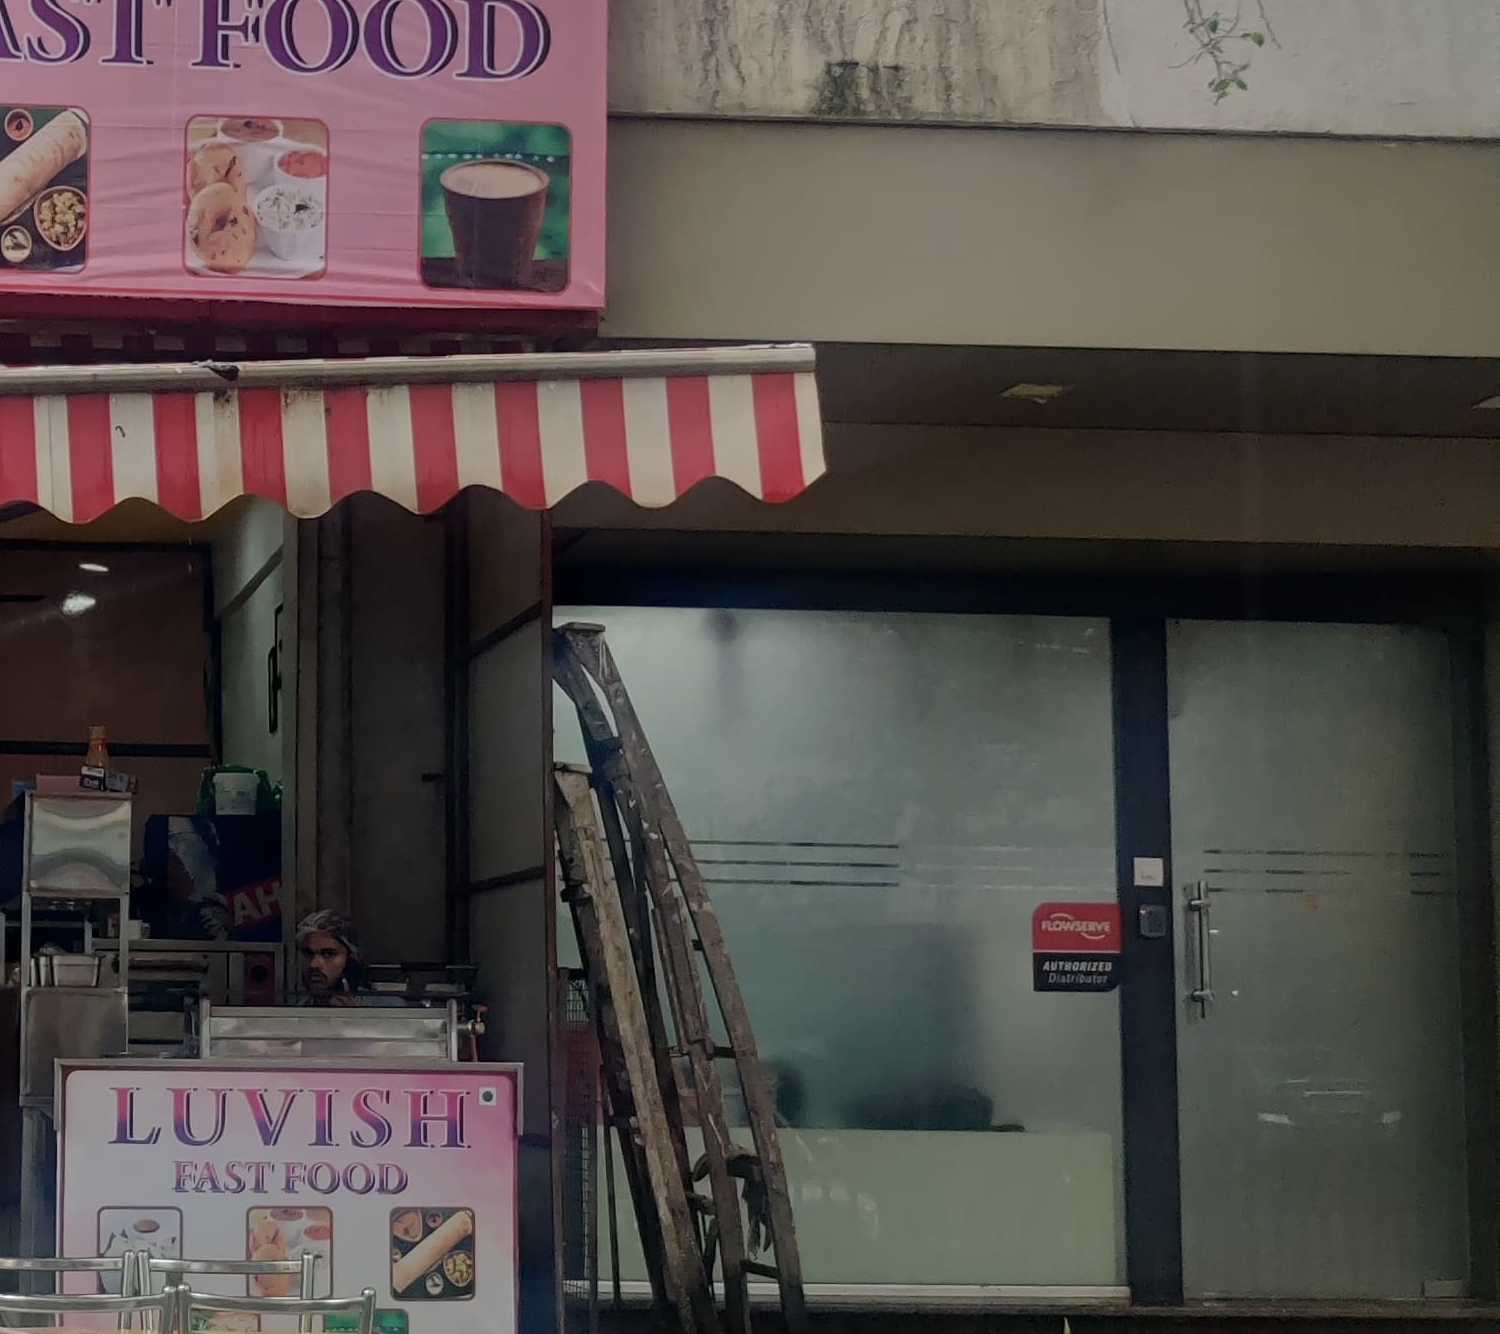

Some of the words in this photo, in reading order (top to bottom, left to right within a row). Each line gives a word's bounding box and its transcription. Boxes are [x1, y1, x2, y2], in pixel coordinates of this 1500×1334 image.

[1040, 920, 1111, 932] FLOWSERVE
[1042, 961, 1113, 972] AUTHORIZED
[107, 1085, 473, 1150] LUVISH
[171, 1160, 275, 1194] FAST
[281, 1160, 409, 1196] FOOD
